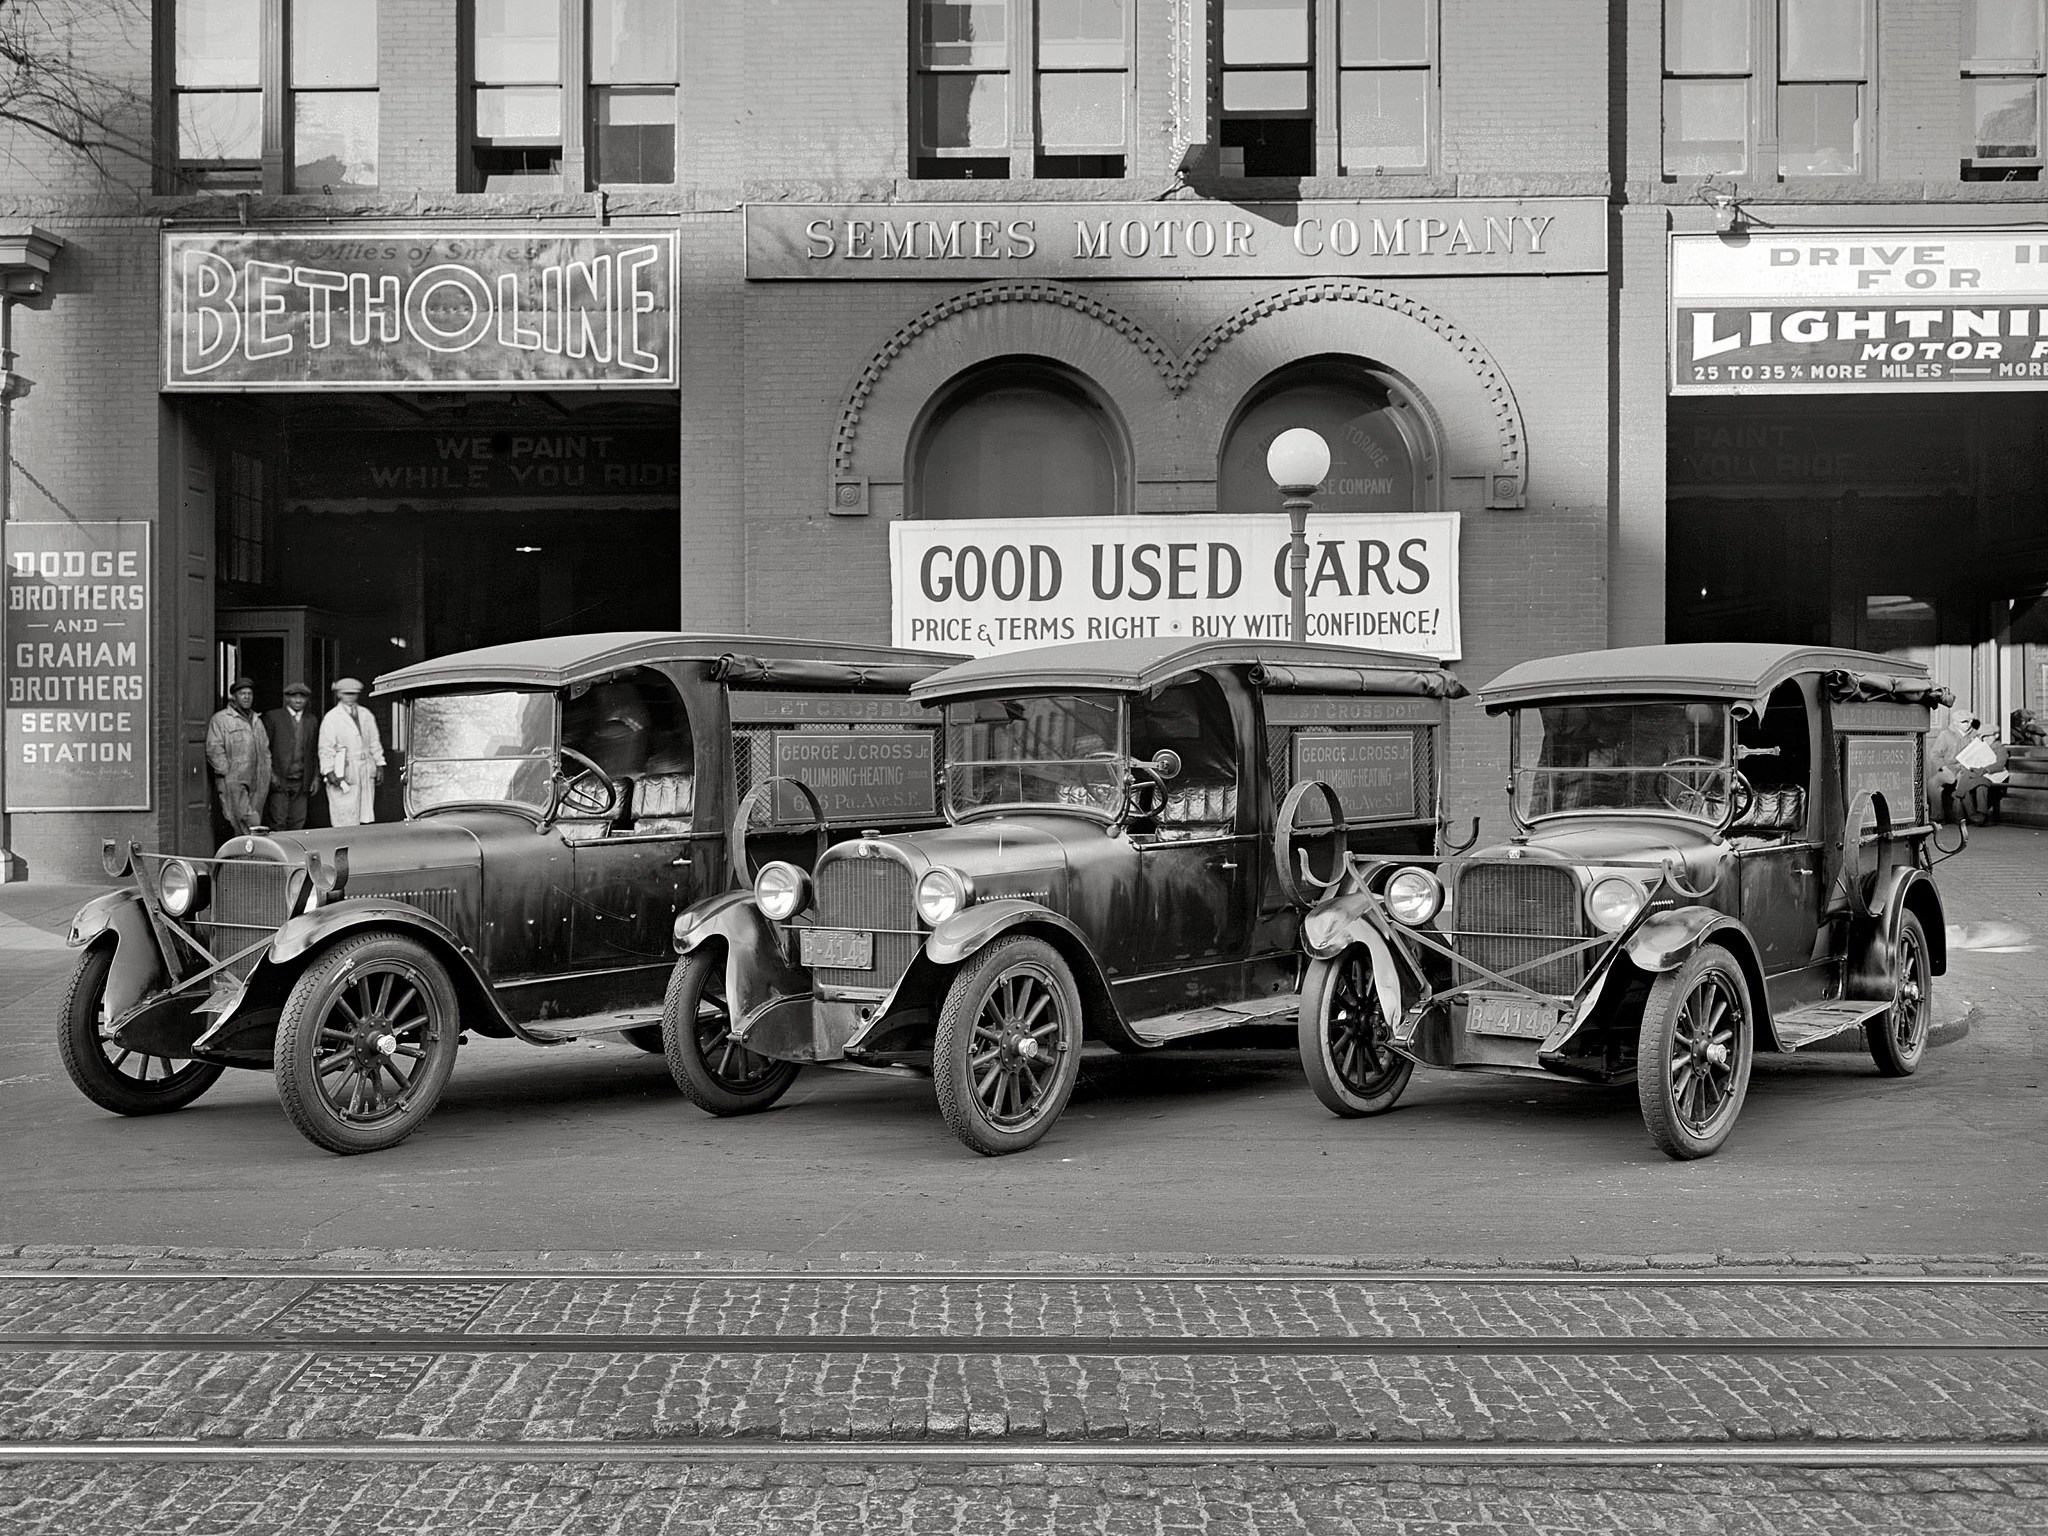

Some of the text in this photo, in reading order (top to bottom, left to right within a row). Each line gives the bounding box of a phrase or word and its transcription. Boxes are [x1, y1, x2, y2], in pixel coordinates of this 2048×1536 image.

[805, 216, 1556, 261] SEMMES MOTOR COMPANY
[409, 243, 434, 266] of
[1769, 246, 1946, 267] DRIVE
[1857, 268, 1982, 289] FOR
[183, 244, 659, 376] BETHOLINE
[1860, 341, 2003, 361] MOTOR
[1694, 365, 1720, 380] 25
[1728, 365, 1754, 380] TO
[1811, 364, 1868, 379] MORE
[1882, 363, 1943, 378] MILES
[434, 436, 614, 460] WE PAINT
[369, 465, 489, 489] WHILE
[509, 464, 586, 487] YOU
[1340, 478, 1394, 495] COMPANY
[13, 550, 138, 578] DODGE
[920, 544, 1063, 602] GOOD
[1091, 543, 1242, 601] USED
[9, 585, 144, 611] BROTHERS
[53, 618, 97, 633] AND
[911, 618, 972, 641] PRICE
[977, 624, 996, 647] &
[994, 617, 1075, 641] TERMS
[1087, 616, 1161, 640] RIGHT
[1192, 614, 1237, 637] BUY
[1306, 608, 1440, 637] CONFIDENCE!
[16, 641, 137, 669] GRAHAM
[9, 675, 143, 702] BROTHERS
[816, 701, 893, 717] CROSS
[21, 711, 131, 733] SERVICE
[22, 742, 132, 763] STATION
[781, 744, 839, 761] GEORGE
[858, 744, 912, 760] CROSS
[1302, 746, 1347, 763] GEORGE
[1358, 745, 1398, 761] CROSS
